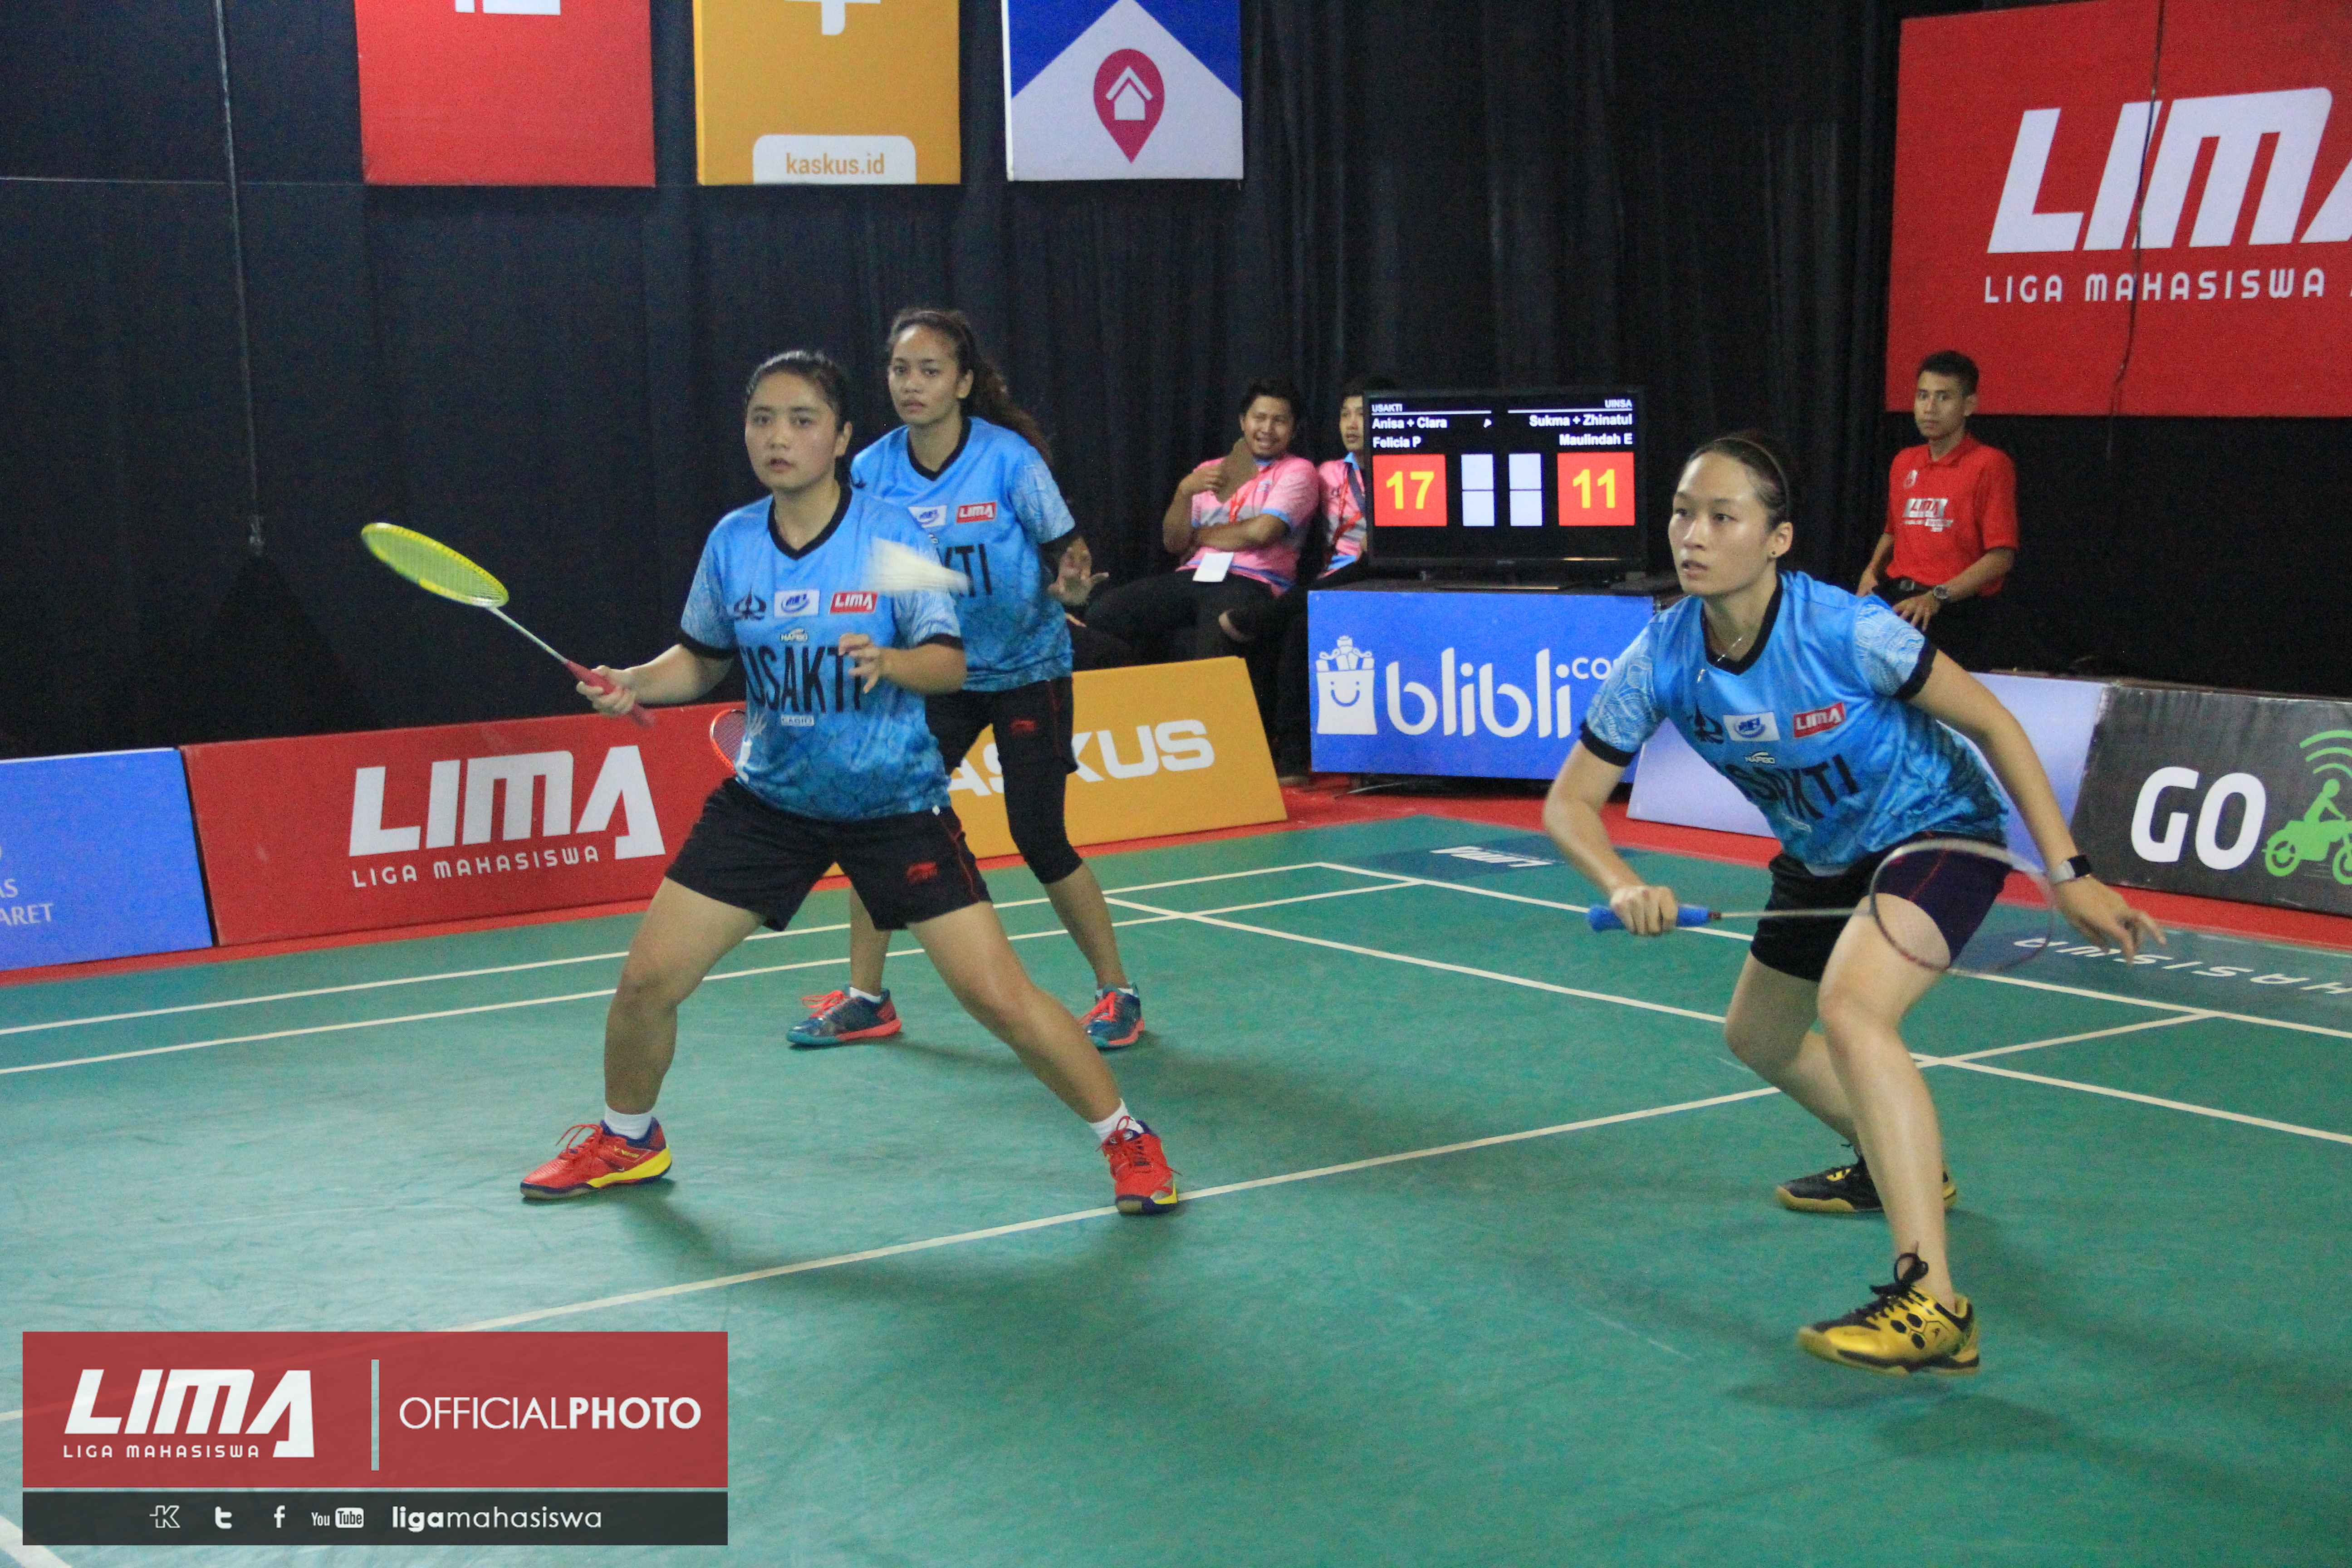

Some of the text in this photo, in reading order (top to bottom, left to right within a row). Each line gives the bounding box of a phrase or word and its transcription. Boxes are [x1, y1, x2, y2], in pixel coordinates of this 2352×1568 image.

[786, 153, 884, 175] kaskus.id
[1984, 268, 2325, 303] LIGA MAHASISWA
[1371, 403, 1402, 412] USAKTI
[1604, 399, 1632, 408] UINSA
[1372, 418, 1405, 429] Anisa
[1416, 416, 1447, 428] Clara
[1529, 415, 1571, 427] Sukma
[1583, 413, 1632, 426] Zhinatul
[1372, 436, 1421, 448] Felicia P
[1559, 432, 1633, 446] Maulindah E
[1386, 471, 1434, 509] 17
[1573, 469, 1615, 509] 11
[835, 593, 873, 610] LIMA
[1797, 708, 1842, 730] LIMA
[349, 745, 666, 860] LIMA
[2131, 766, 2266, 870] GO
[352, 845, 599, 888] LIGA MAHASISWA
